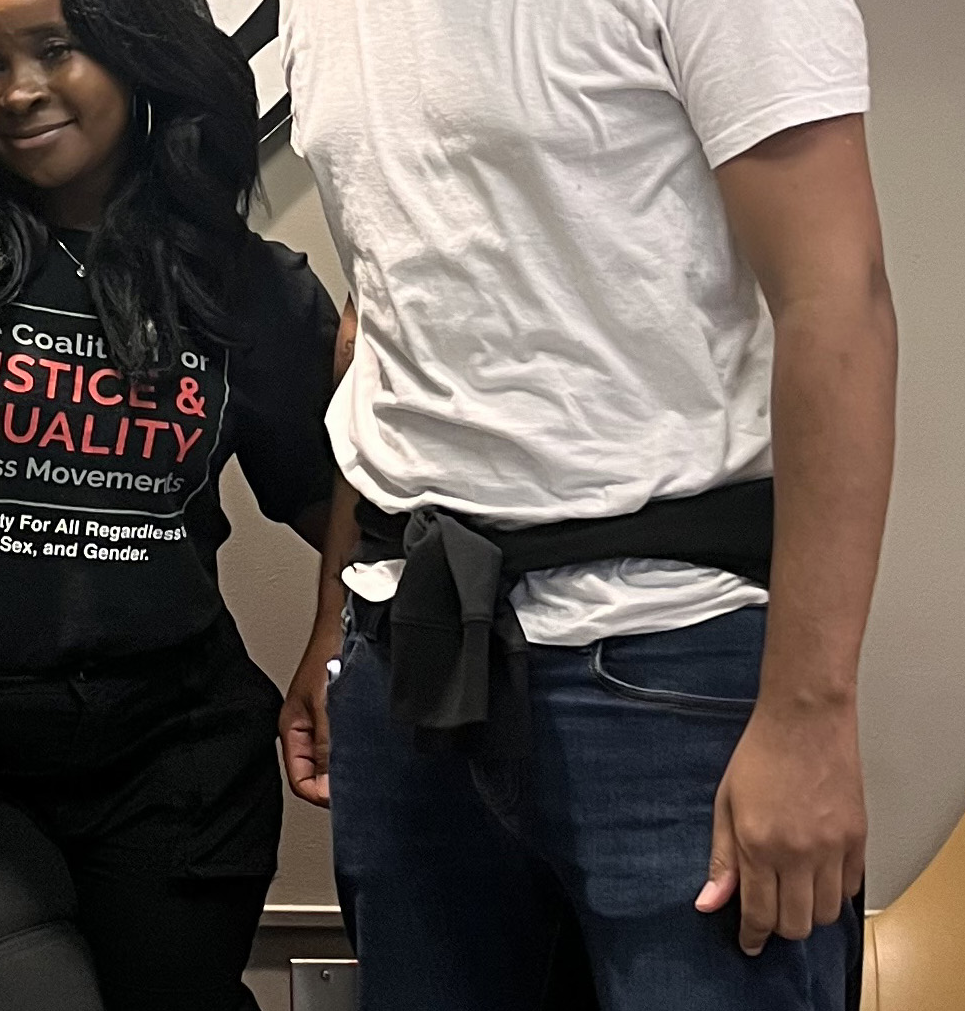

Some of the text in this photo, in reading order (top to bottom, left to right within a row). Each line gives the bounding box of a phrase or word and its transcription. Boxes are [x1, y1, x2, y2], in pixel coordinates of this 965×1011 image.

[176, 376, 207, 418] &
[26, 457, 185, 494] Movements
[19, 514, 51, 533] For
[55, 519, 80, 536] All
[85, 520, 182, 542] Regardless
[0, 535, 38, 557] Sex,
[43, 542, 78, 558] and
[83, 543, 150, 561] Gender.
